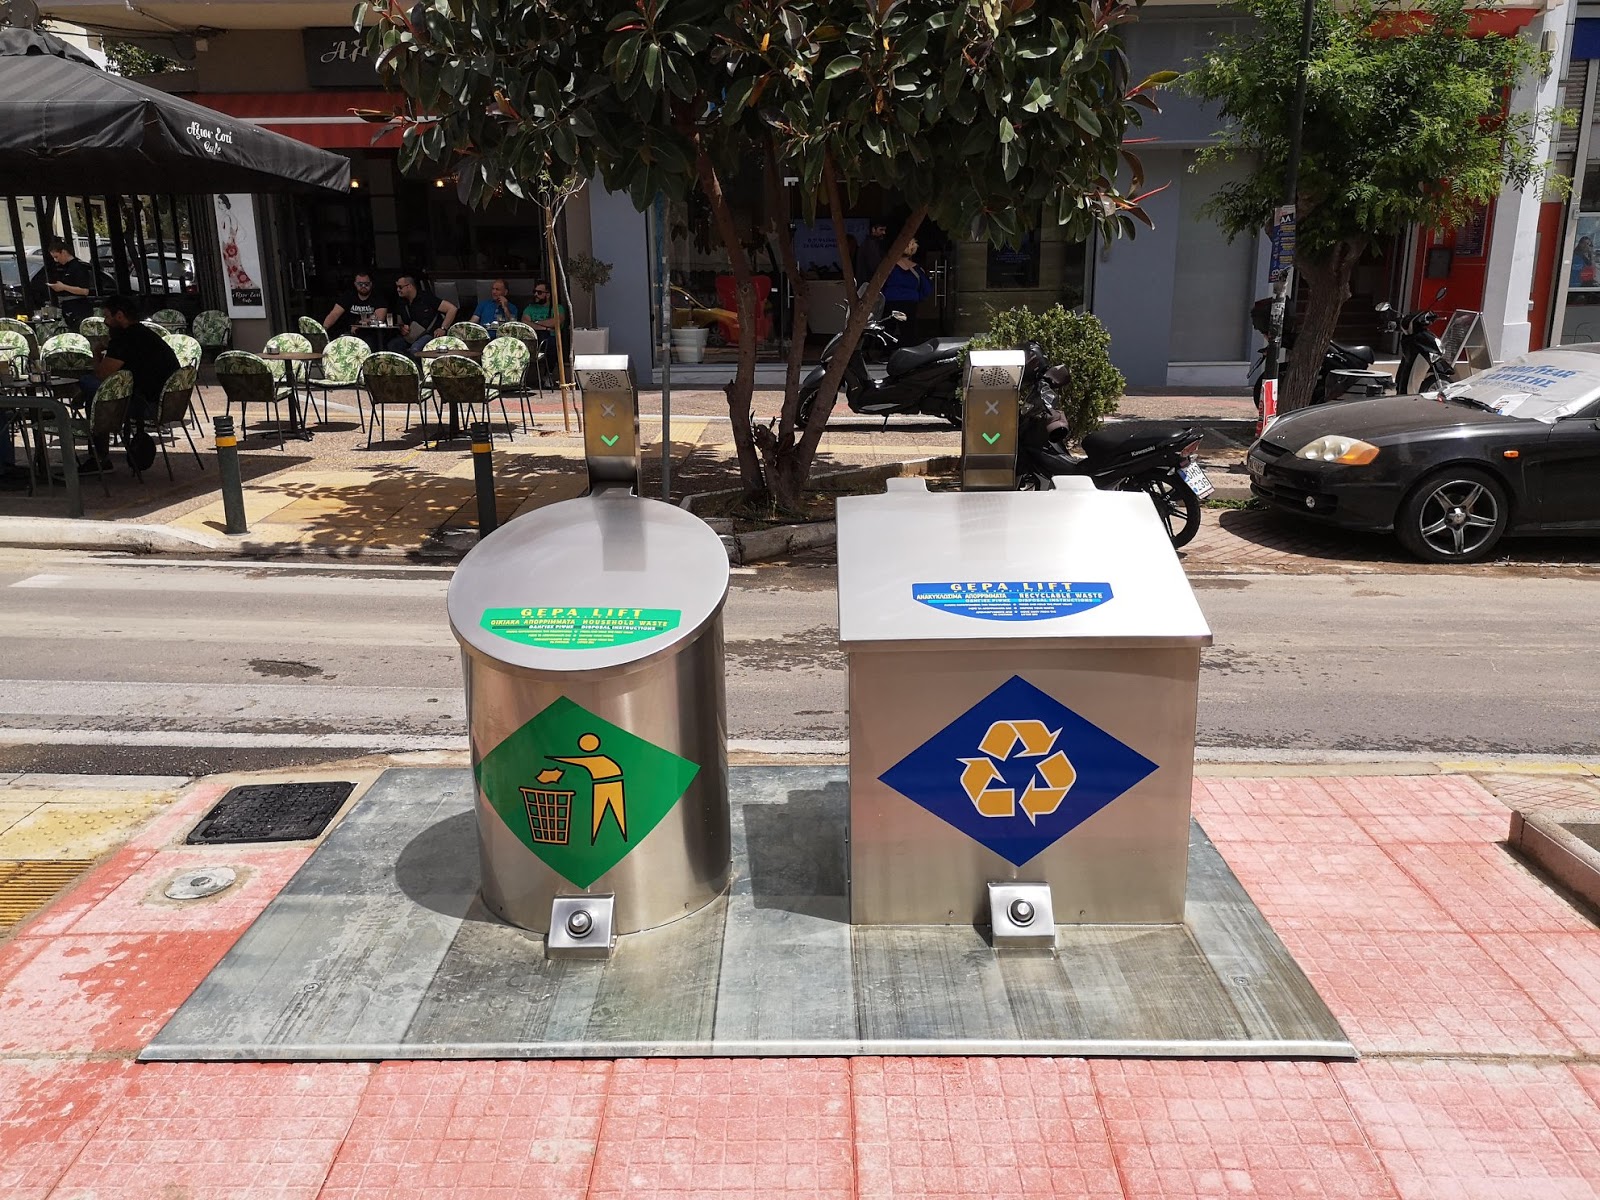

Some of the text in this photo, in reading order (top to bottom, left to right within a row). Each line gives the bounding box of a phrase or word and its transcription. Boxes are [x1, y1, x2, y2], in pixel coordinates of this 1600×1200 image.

[950, 583, 1008, 591] GEPA
[1022, 582, 1072, 590] LIFT
[520, 608, 578, 617] GEPA
[592, 608, 643, 617] LIFT
